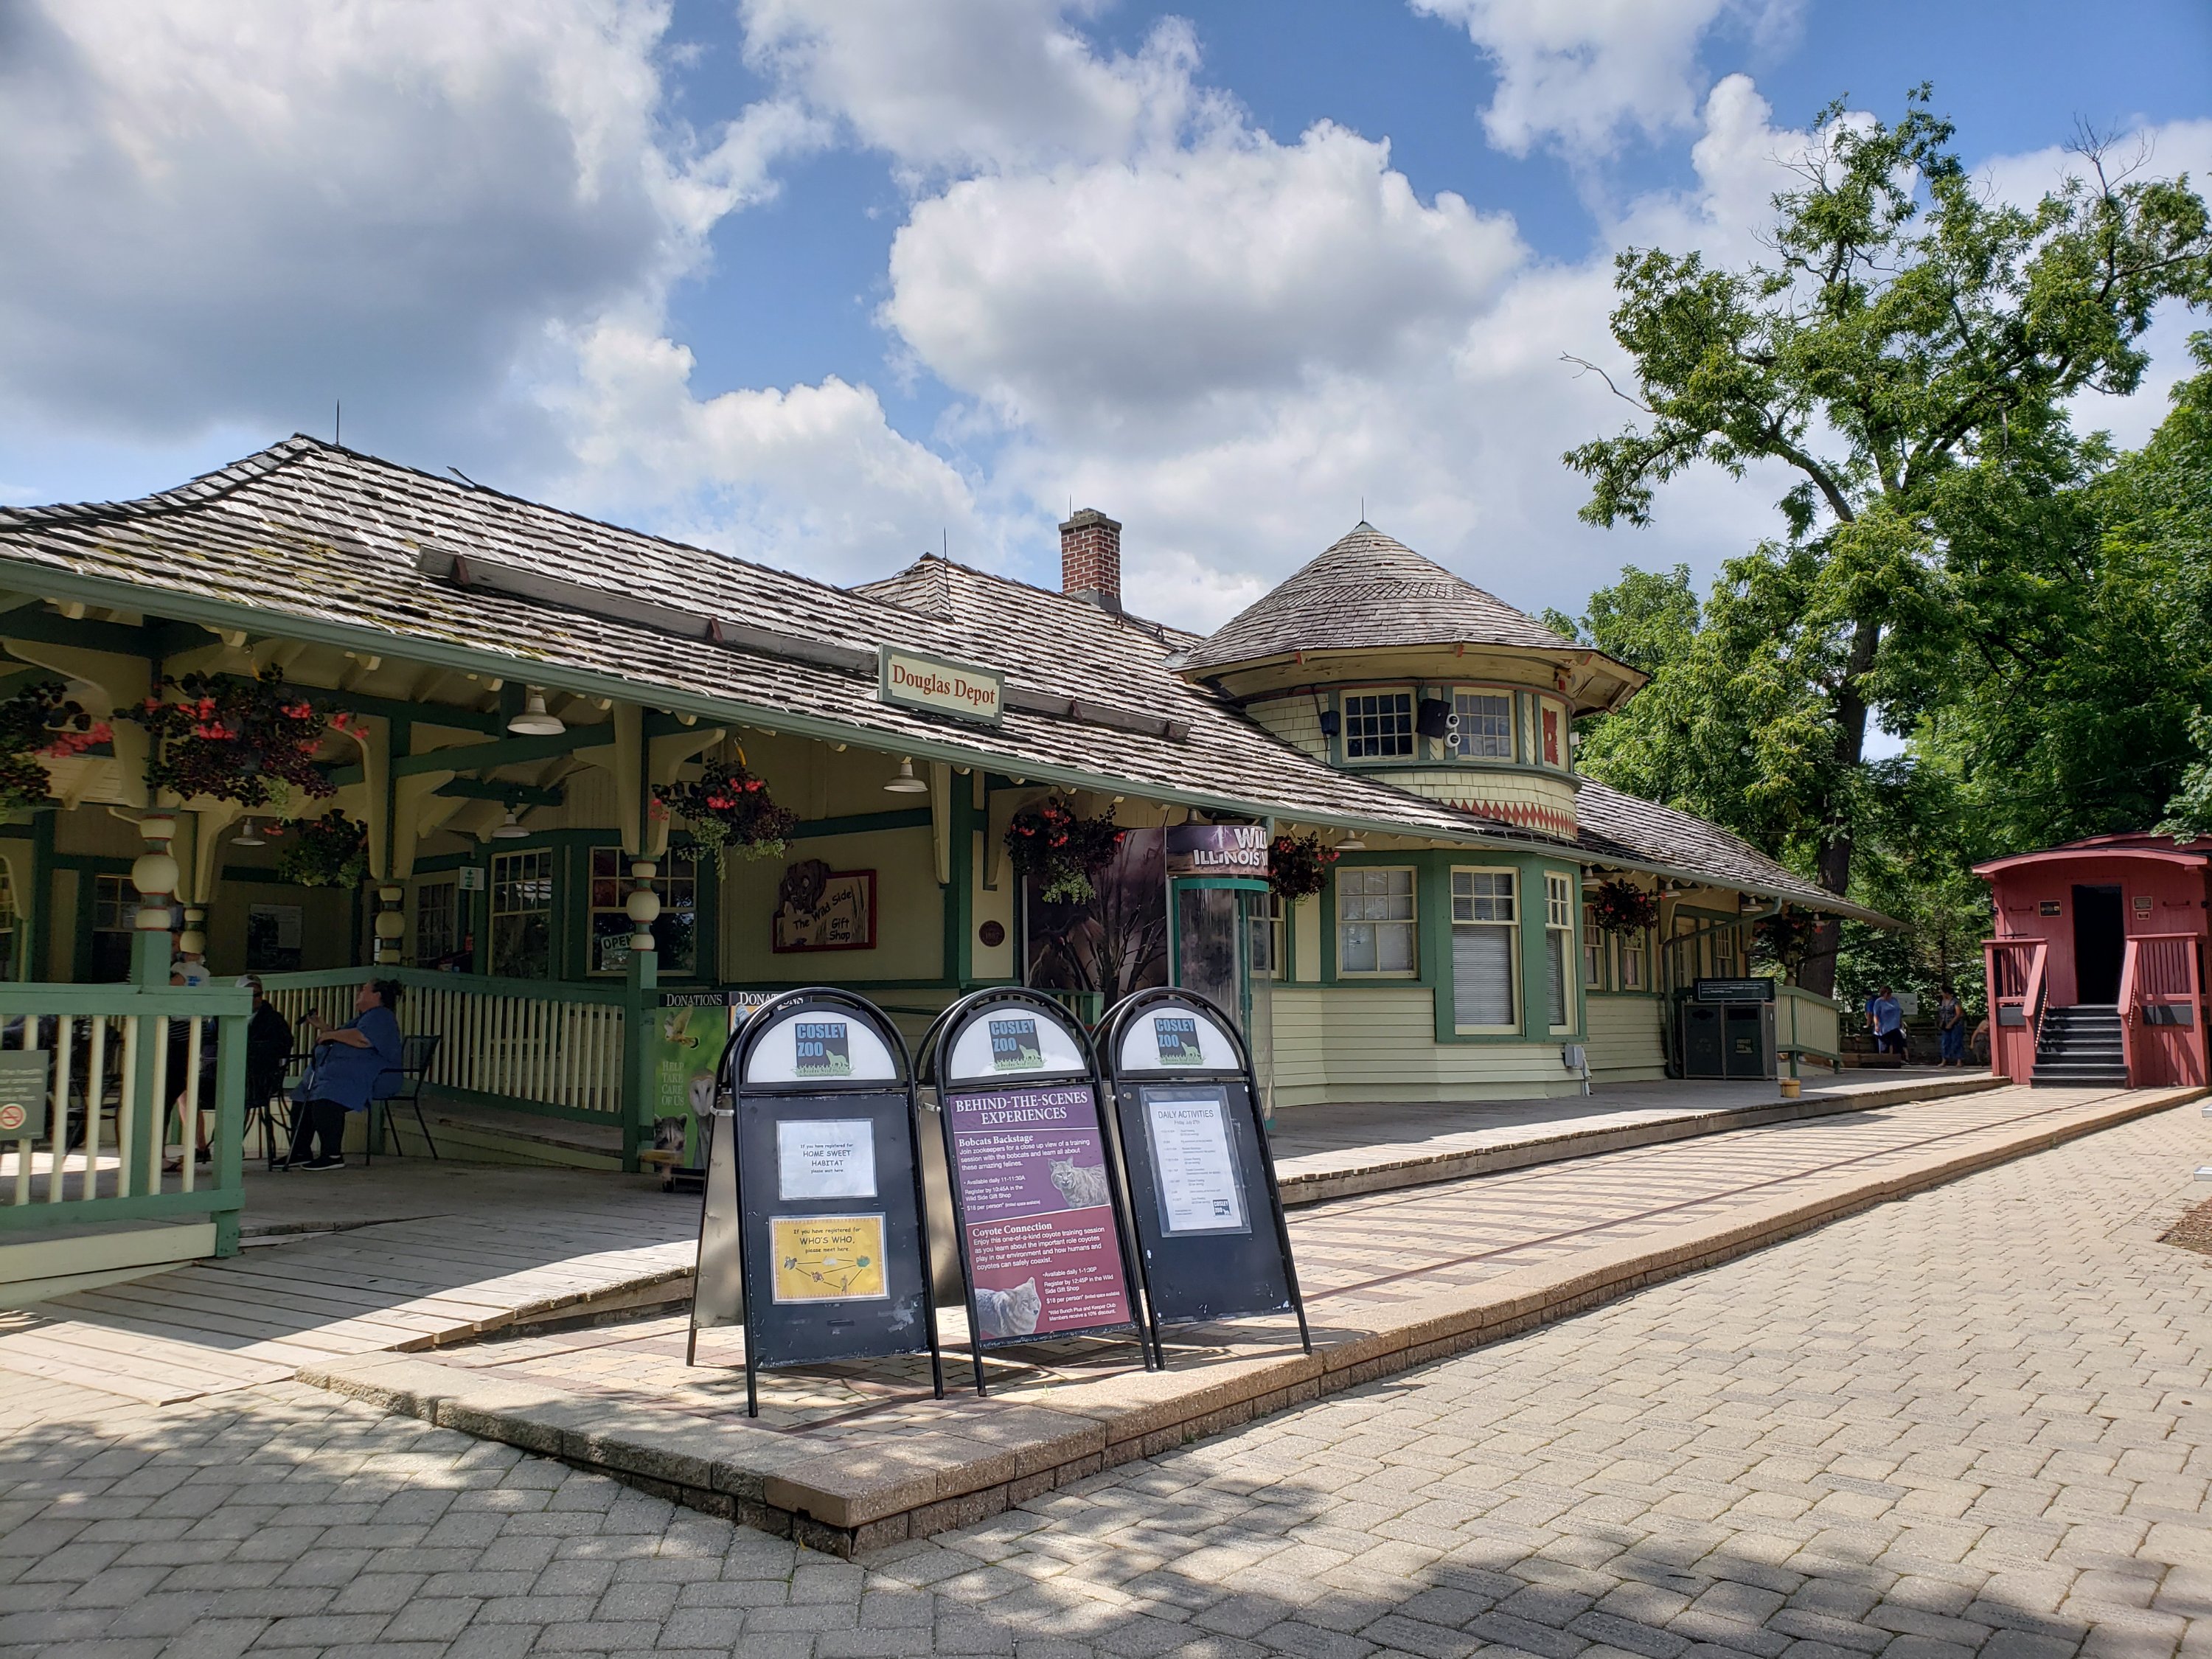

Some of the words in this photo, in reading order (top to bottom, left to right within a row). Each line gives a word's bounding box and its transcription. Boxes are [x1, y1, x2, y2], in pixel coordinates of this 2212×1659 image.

[892, 664, 950, 695] Douglas
[954, 678, 995, 706] Depot
[793, 919, 810, 930] The
[812, 902, 830, 922] Wild
[832, 889, 852, 906] Side
[832, 918, 849, 929] Gift
[830, 931, 851, 942] Shop
[796, 1024, 846, 1039] COSLEY
[990, 1020, 1035, 1035] COSLEY
[1155, 1019, 1194, 1032] COSLEY
[992, 1037, 1017, 1052] ZOO
[1158, 1034, 1180, 1048] ZOO
[797, 1042, 824, 1057] ZOO
[955, 1091, 1088, 1113] BEHIND-THE-SCENES
[981, 1107, 1068, 1125] EXPERIENCES
[1158, 1110, 1177, 1119] DAILY
[1178, 1109, 1214, 1119] ACTIVITIES
[959, 1137, 992, 1147] Bobcats
[992, 1134, 1034, 1144] Backstage
[973, 1228, 1002, 1238] Coyote
[1004, 1222, 1052, 1234] Connection
[799, 1237, 829, 1245] WHO'S
[1038, 1239, 1065, 1247] important
[975, 1255, 988, 1263] play
[1006, 1250, 1041, 1259] environment
